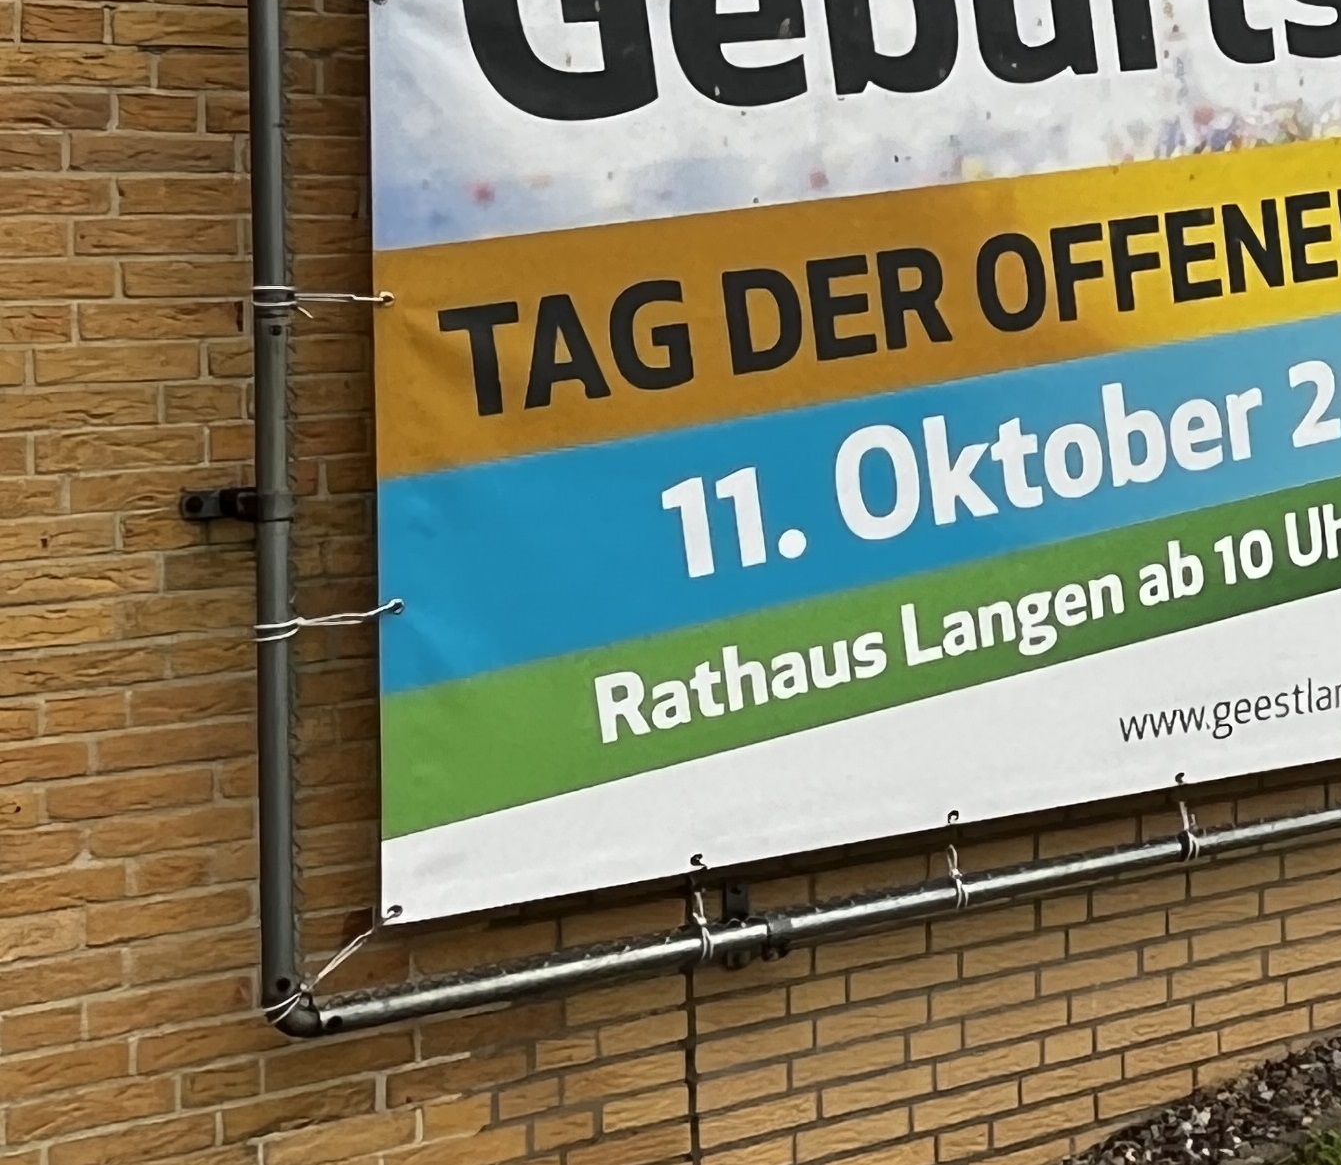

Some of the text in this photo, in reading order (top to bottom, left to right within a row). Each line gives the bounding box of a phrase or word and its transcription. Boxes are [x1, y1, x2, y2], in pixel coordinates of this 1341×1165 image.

[439, 279, 694, 417] TAG
[721, 248, 953, 376] DER
[662, 466, 806, 579] 11.
[833, 382, 1262, 541] Oktober
[594, 630, 887, 743] Rathaus
[902, 559, 1124, 667] Langen
[1139, 542, 1204, 607] ab
[1213, 529, 1274, 587] 10
